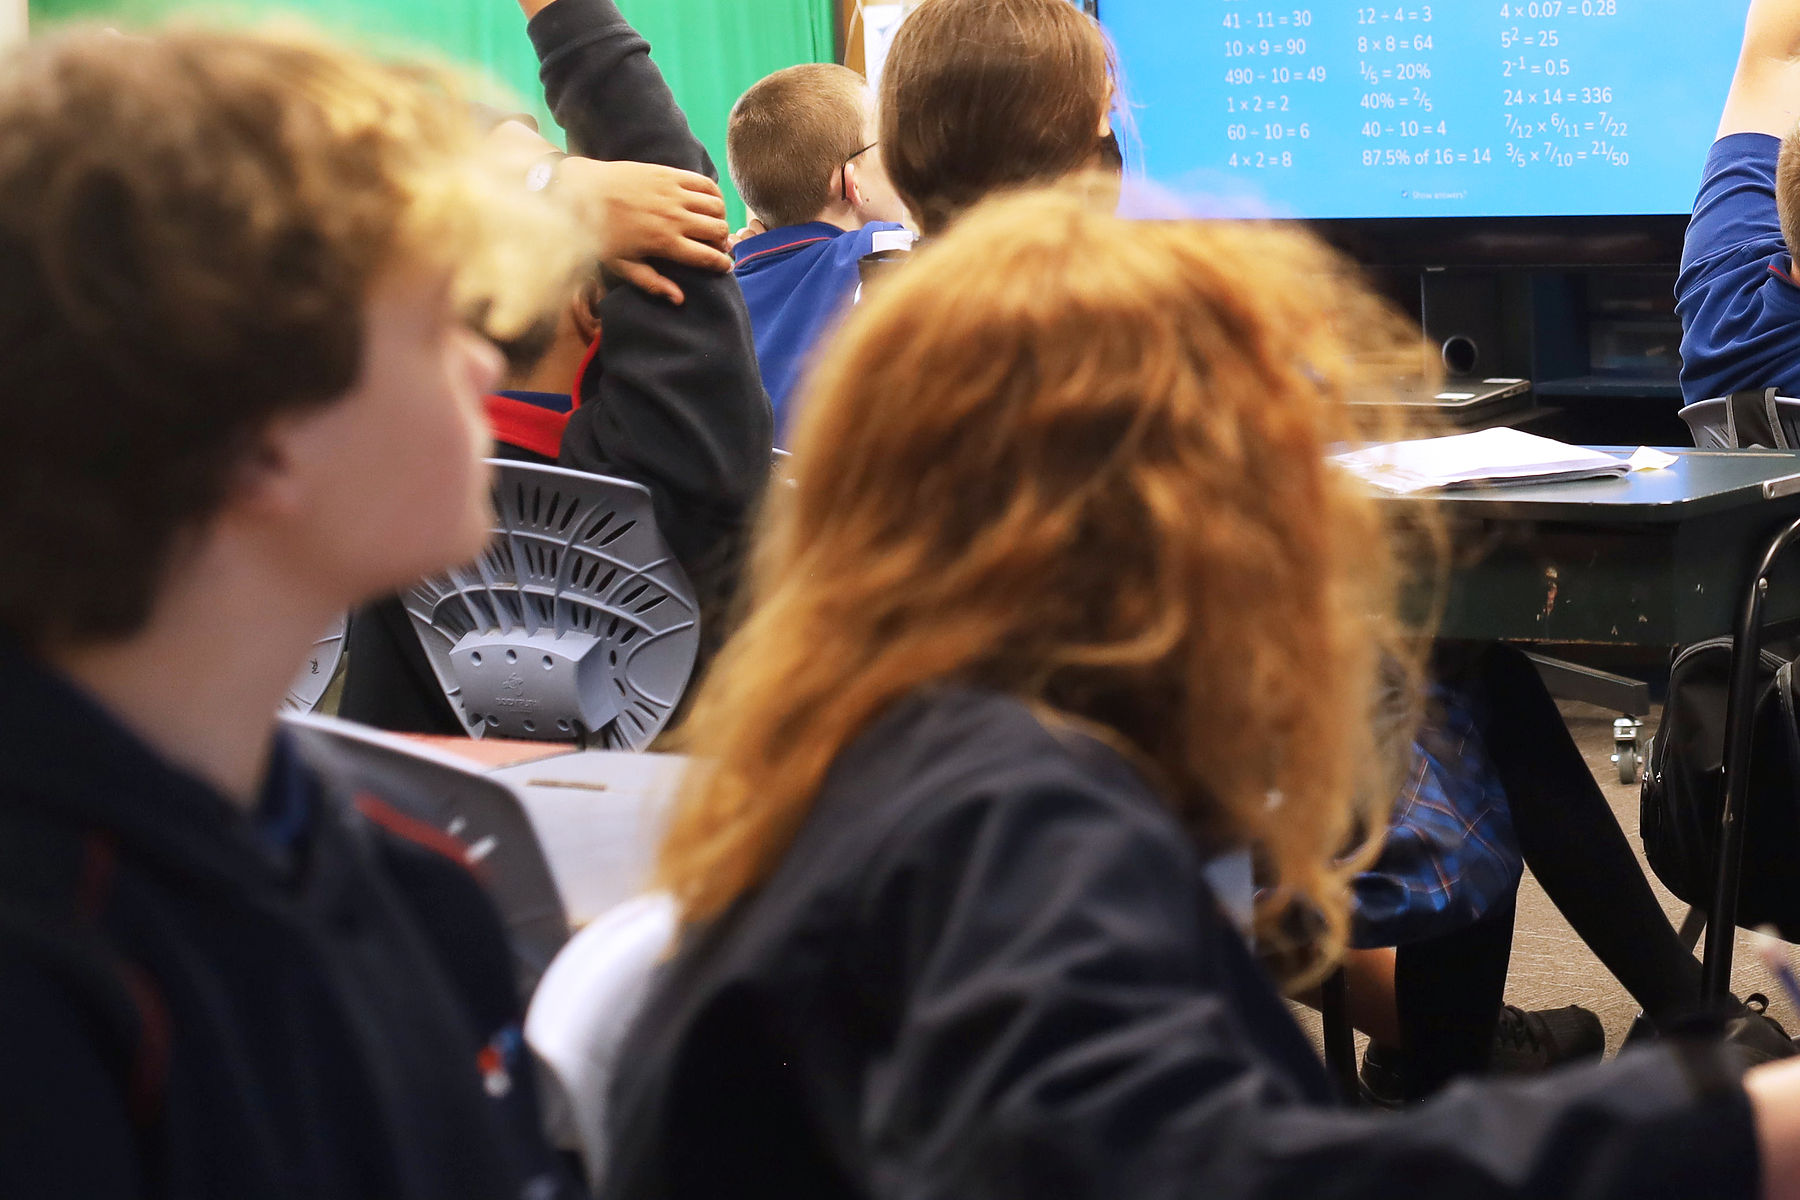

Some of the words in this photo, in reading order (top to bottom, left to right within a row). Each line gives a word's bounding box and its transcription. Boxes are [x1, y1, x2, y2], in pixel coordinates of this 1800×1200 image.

[1357, 8, 1376, 24] 12
[1394, 8, 1404, 22] 4
[1422, 6, 1432, 22] 3
[1500, 3, 1509, 19] 4
[1528, 1, 1562, 18] 0.07
[1581, 0, 1617, 16] 0.28
[1223, 13, 1240, 28] 41
[1257, 12, 1274, 27] 11
[1293, 10, 1311, 26] 30
[1357, 36, 1367, 52] 8
[1385, 35, 1395, 52] 8
[1414, 34, 1433, 50] 64
[1538, 30, 1559, 47] 25
[1225, 40, 1242, 57] 10
[1259, 40, 1269, 56] 9
[1286, 38, 1306, 55] 90
[1225, 68, 1253, 84] 490
[1271, 67, 1289, 83] 10
[1307, 66, 1326, 83] 49
[1396, 63, 1431, 80] 20%
[1545, 59, 1570, 76] 0.5
[1227, 96, 1235, 112] 1
[1253, 96, 1262, 112] 2
[1280, 95, 1289, 111] 2
[1360, 93, 1394, 109] 40%
[1504, 89, 1523, 106] 24
[1544, 89, 1562, 105] 14
[1581, 87, 1612, 104] 336
[1227, 124, 1246, 140] 60
[1265, 123, 1283, 139] 10
[1300, 123, 1310, 139] 6
[1361, 122, 1381, 137] 40
[1400, 120, 1419, 136] 10
[1437, 120, 1447, 136] 4
[1229, 152, 1238, 167] 4
[1256, 152, 1264, 168] 2
[1282, 151, 1292, 167] 8
[1362, 149, 1410, 166] 87.5%
[1414, 149, 1429, 164] of
[1435, 148, 1453, 164] 16
[1473, 148, 1492, 164] 14
